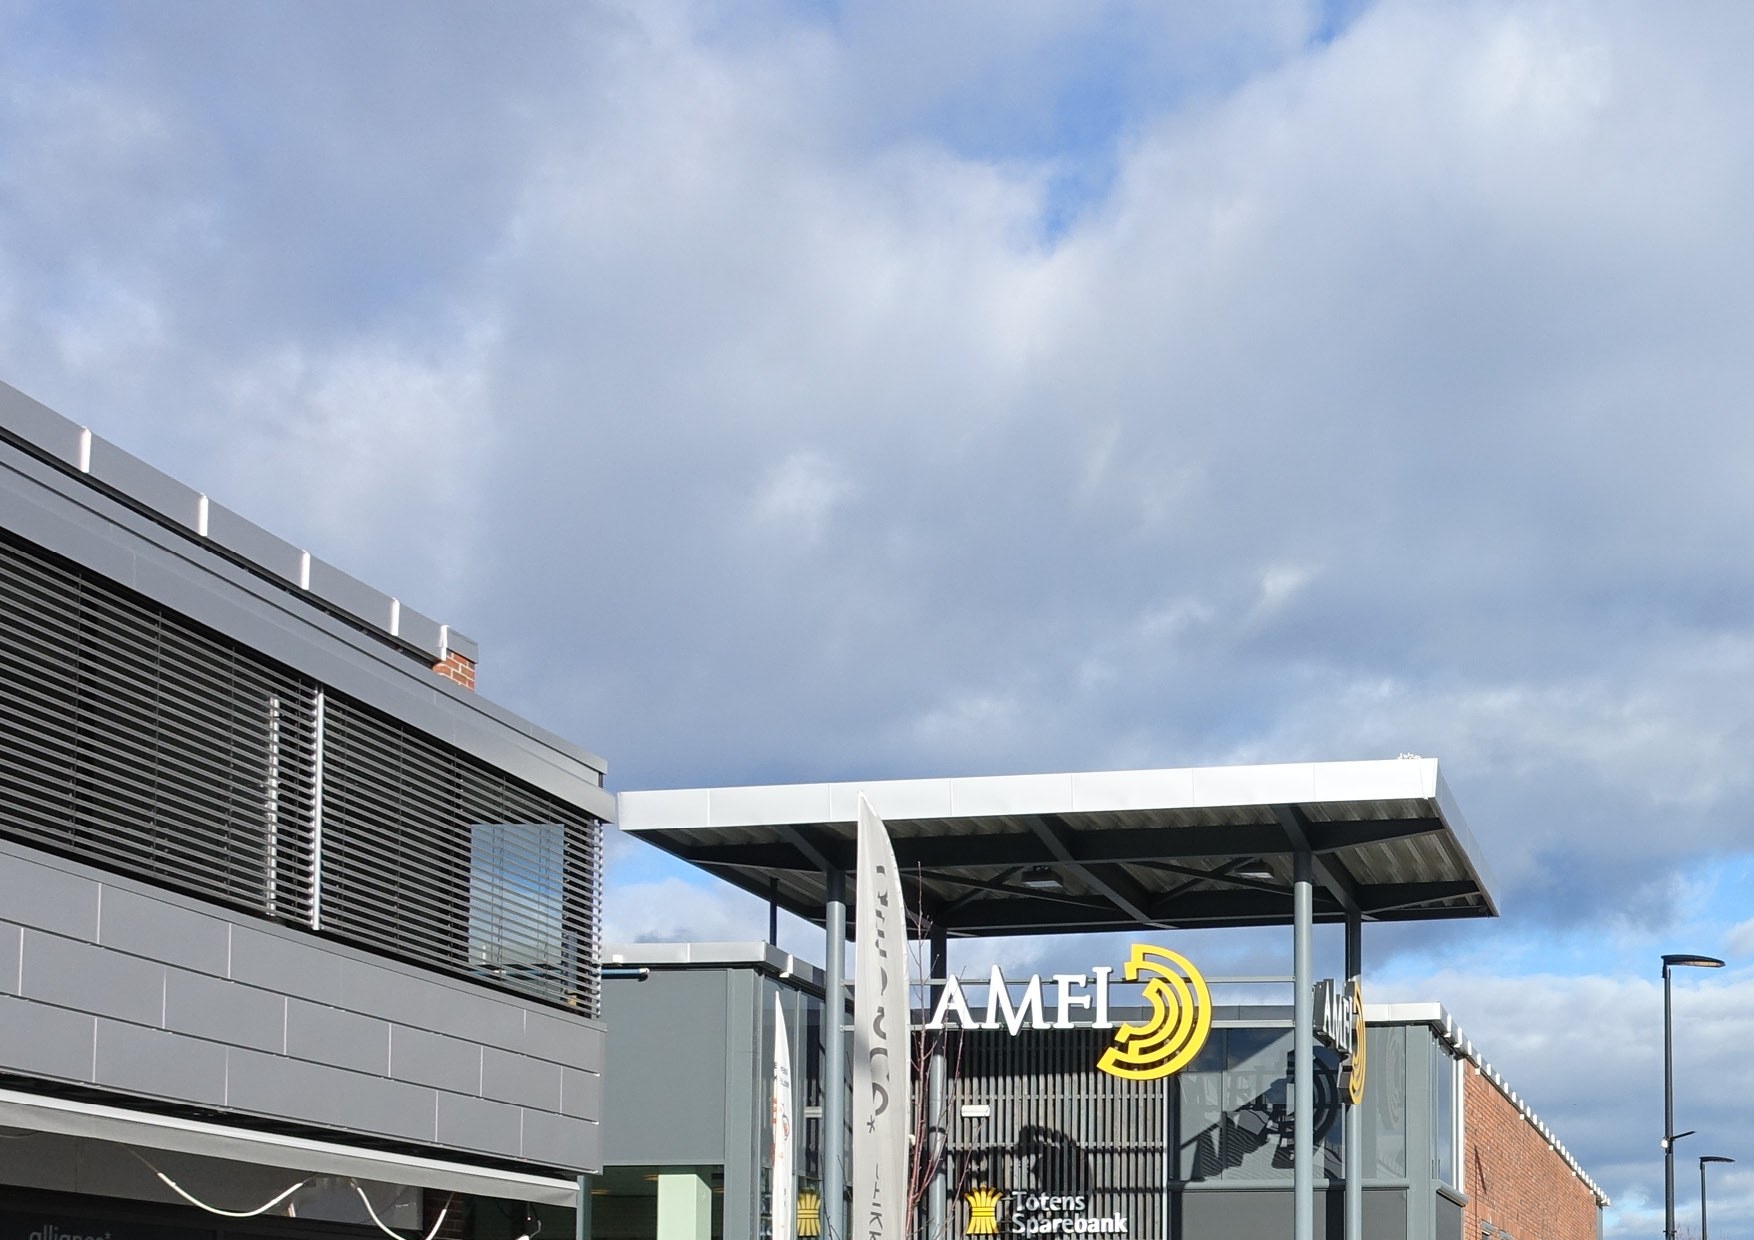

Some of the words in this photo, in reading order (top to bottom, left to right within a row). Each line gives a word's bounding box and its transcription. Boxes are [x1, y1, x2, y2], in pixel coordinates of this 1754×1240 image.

[925, 965, 1113, 1036] AMFI
[1322, 978, 1353, 1054] AMFI
[1011, 1191, 1086, 1212] Totens
[1011, 1212, 1128, 1239] Sparebank
